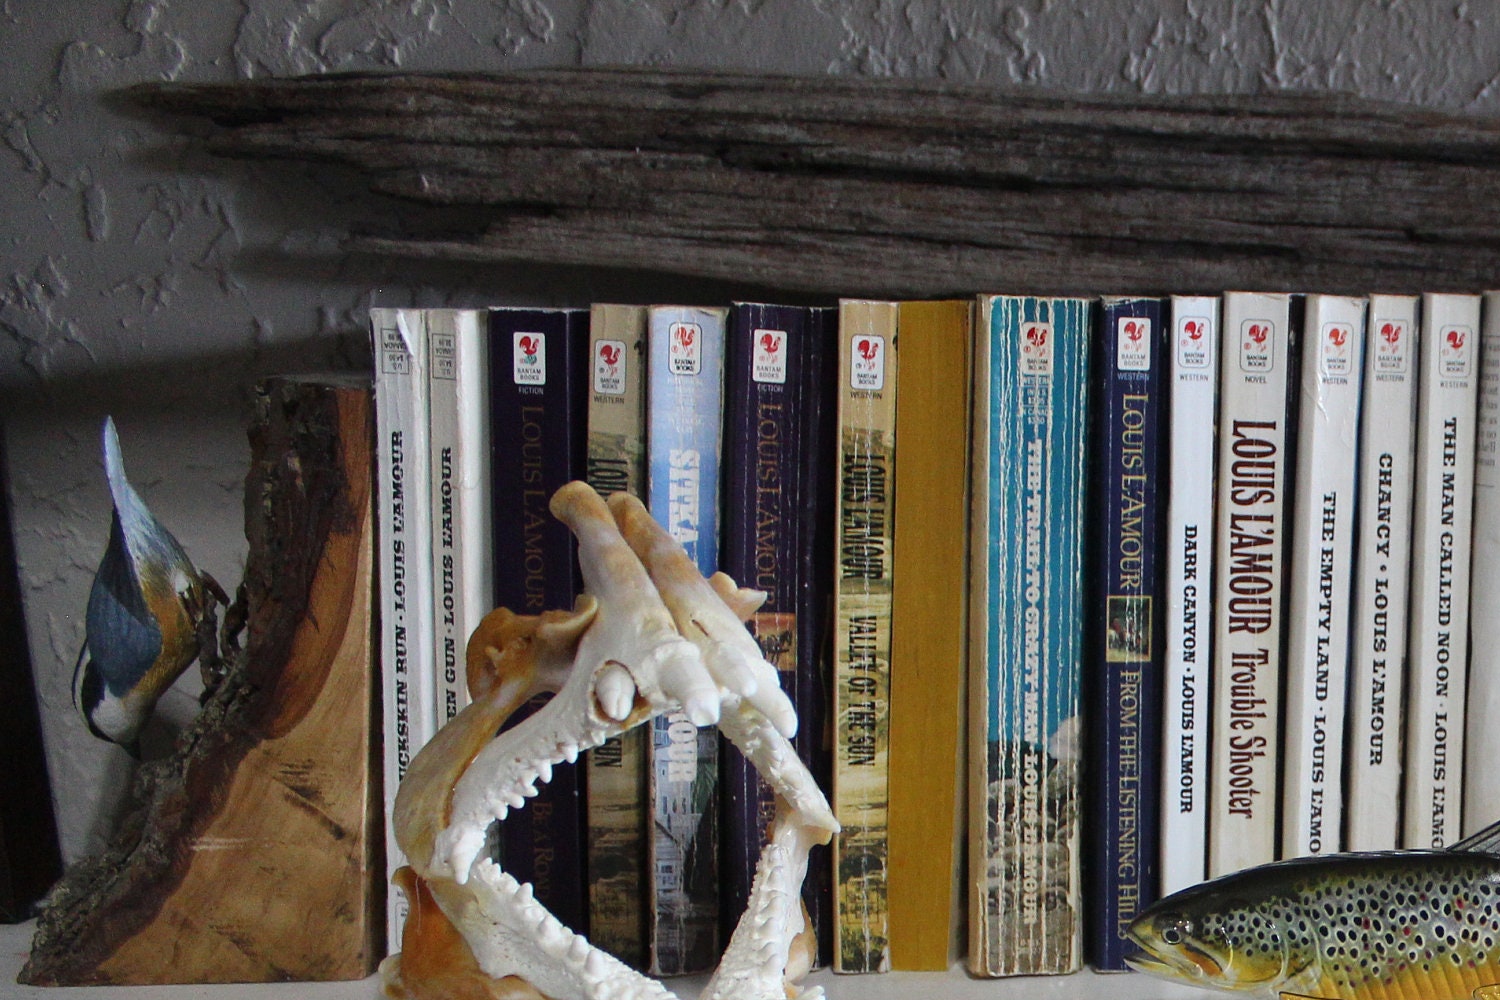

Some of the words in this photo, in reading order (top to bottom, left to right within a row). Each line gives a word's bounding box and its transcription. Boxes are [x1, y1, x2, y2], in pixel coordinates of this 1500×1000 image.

[518, 367, 542, 375] BANTAM
[518, 386, 544, 396] FICTION
[757, 366, 781, 374] BANTAM
[759, 372, 779, 380] BOOKS
[1117, 373, 1150, 382] WESTERN
[1124, 360, 1144, 368] BOOKS
[1180, 374, 1209, 382] WESTERN
[1185, 358, 1204, 366] BOOKS
[1244, 375, 1268, 384] NOVEL
[1247, 360, 1266, 368] BOOKS
[594, 395, 625, 405] WESTERN
[521, 405, 545, 484] LOUIS
[756, 402, 784, 483] LOUIS
[1120, 393, 1149, 470] LOUIS
[1442, 416, 1458, 467] THE
[391, 430, 404, 537] L'AMOUR
[843, 453, 887, 504] LOUIS
[1026, 438, 1043, 491] THE
[1229, 419, 1278, 507] LOUIS
[441, 446, 453, 549] L'AMOUR
[668, 448, 701, 546] SITKA
[1321, 491, 1337, 542] THE
[1376, 453, 1394, 558] CHANCY
[1440, 473, 1456, 526] MAN
[522, 491, 548, 609] L'AMOUR
[1119, 472, 1148, 589] L'AMOUR
[1183, 524, 1199, 583] DARK
[394, 540, 407, 613] LOUIS
[443, 557, 455, 626] LOUIS
[1227, 512, 1276, 634] L'AMOUR
[1317, 548, 1335, 635] EMPTY
[1436, 531, 1454, 627] CALLED
[848, 614, 878, 673] VALLEY
[1181, 586, 1198, 664] CANYON
[1372, 578, 1389, 653] LOUIS
[395, 624, 409, 678] RUN
[445, 637, 456, 692] GUN
[1315, 636, 1331, 701] LAND
[1435, 631, 1451, 698] NOON
[847, 676, 877, 698] OF
[847, 700, 877, 731] THE
[1118, 670, 1142, 728] FROM
[1180, 675, 1196, 731] LOUIS
[1228, 648, 1270, 731] Trouble
[1369, 659, 1386, 766] L'AMOUR
[847, 735, 877, 767] SUN
[1118, 731, 1140, 772] THE
[1178, 733, 1195, 815] L'AMOUR
[1227, 733, 1268, 820] Shooter
[1311, 714, 1327, 784] LOUIS
[1432, 711, 1448, 782] LOUIS
[1117, 775, 1140, 877] LISTENING
